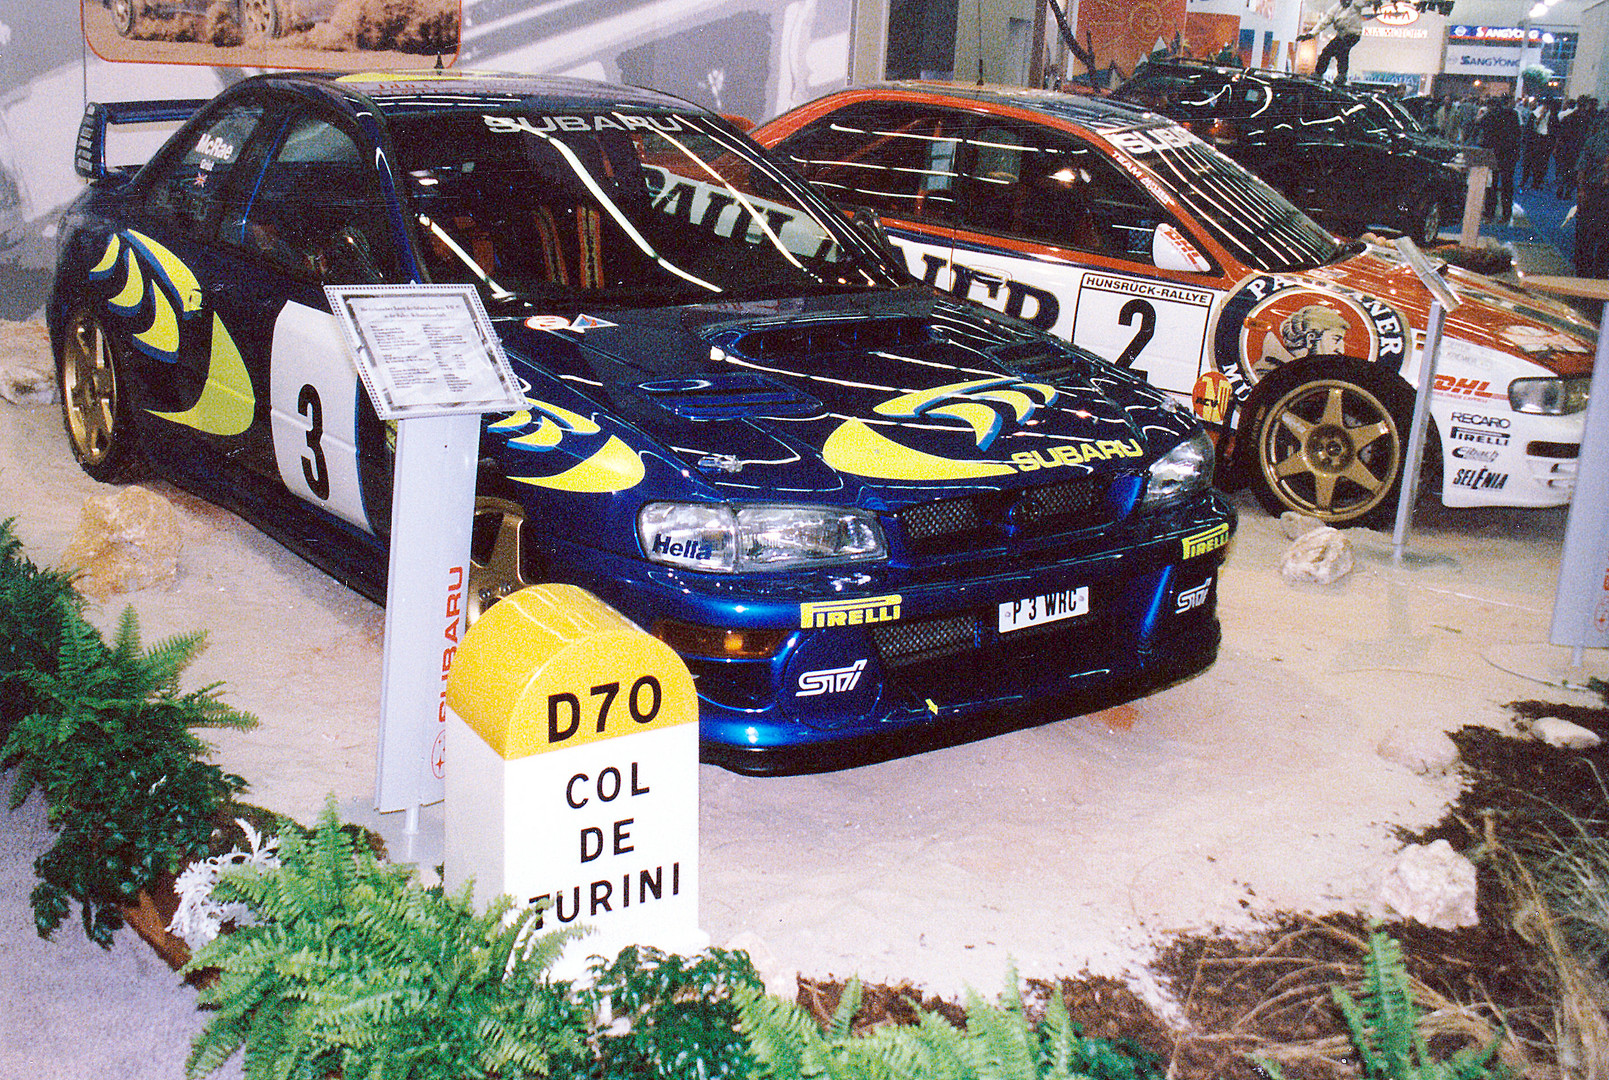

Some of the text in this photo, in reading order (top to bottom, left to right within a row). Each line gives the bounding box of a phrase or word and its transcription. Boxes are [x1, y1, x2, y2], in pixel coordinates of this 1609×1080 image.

[483, 114, 683, 133] SUBARU
[195, 132, 234, 160] McRae
[1112, 150, 1143, 178] TEAM
[1086, 276, 1208, 304] HUNSRÜCK-RALLYE
[1116, 299, 1158, 382] 2
[1433, 374, 1493, 398] DHL
[1450, 426, 1511, 446] PIRELLI
[1451, 411, 1511, 429] RECARO
[297, 383, 330, 501] 3
[1011, 437, 1145, 472] SUBARU
[652, 533, 712, 561] Hella
[1181, 522, 1230, 560] PIRELLI
[800, 594, 903, 629] PIRELLI
[1012, 590, 1077, 624] P 3 WRC
[547, 674, 663, 745] D70
[565, 761, 651, 810] COL
[579, 817, 636, 864] DE
[529, 861, 681, 931] TURINI
